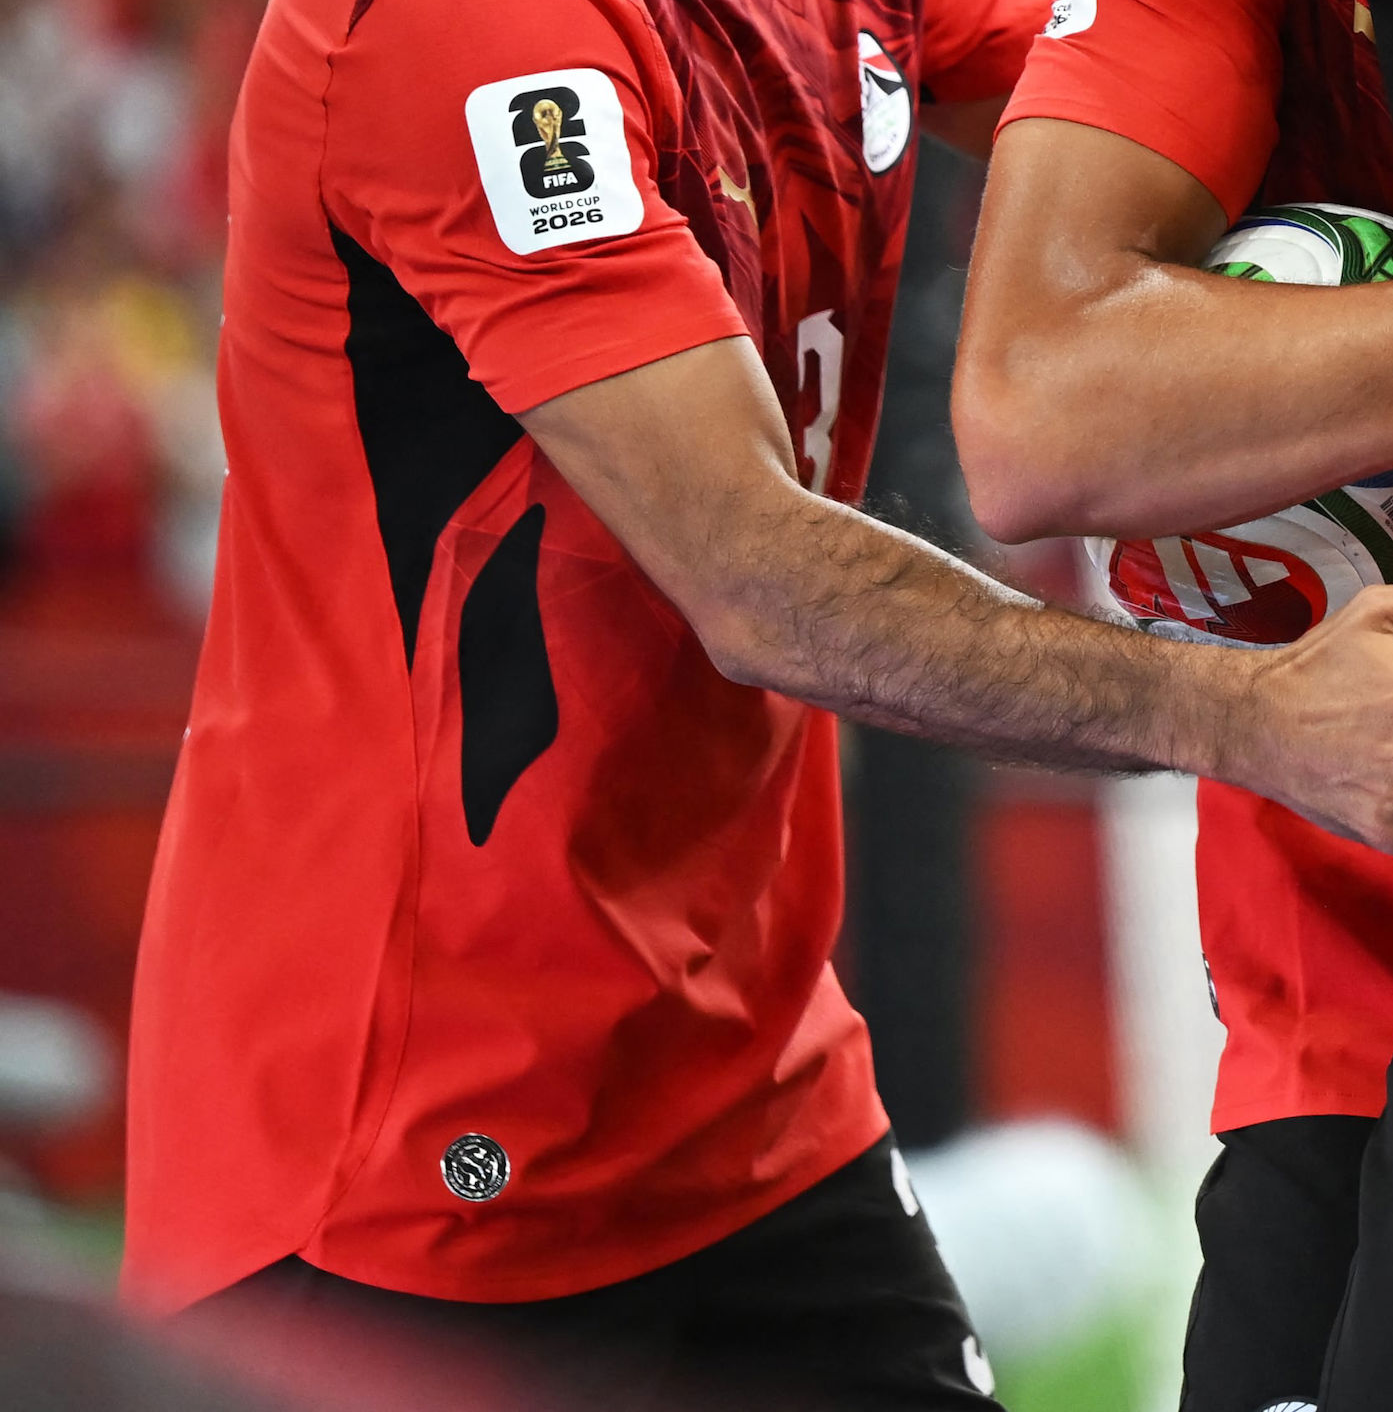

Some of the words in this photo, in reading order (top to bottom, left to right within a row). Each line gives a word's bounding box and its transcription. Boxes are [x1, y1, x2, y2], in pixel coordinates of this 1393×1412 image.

[542, 172, 578, 189] FIFA
[529, 199, 574, 217] WORLD
[576, 196, 600, 207] CUP
[532, 208, 604, 235] 2026
